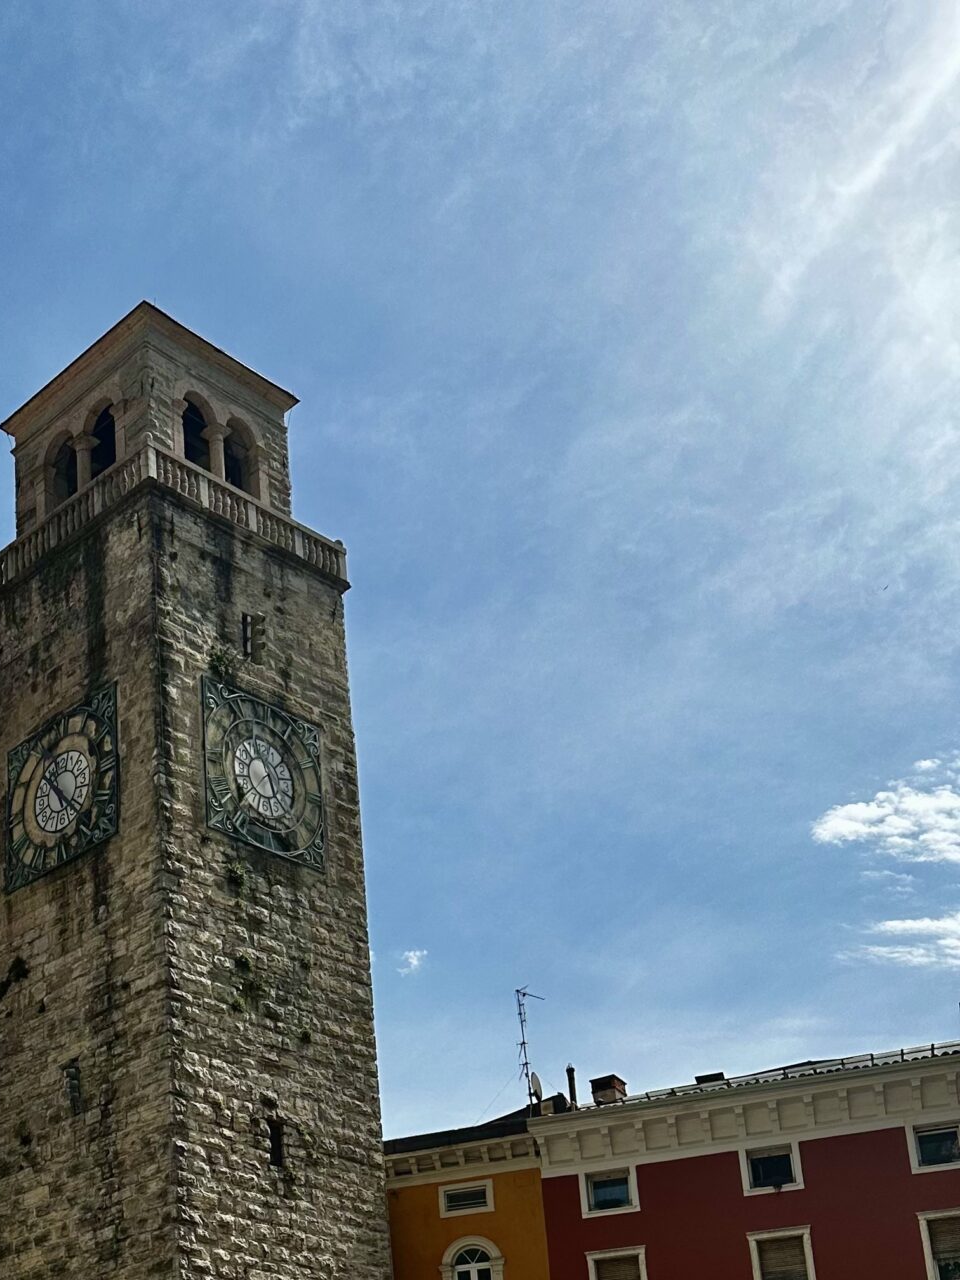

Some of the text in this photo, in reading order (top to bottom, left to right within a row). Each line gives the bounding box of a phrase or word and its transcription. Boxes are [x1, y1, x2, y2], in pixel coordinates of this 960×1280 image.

[238, 747, 248, 761] 10
[57, 757, 66, 770] 12
[76, 759, 83, 772] 2
[238, 762, 245, 774] 9
[279, 764, 286, 777] 2
[80, 772, 86, 784] 3
[242, 778, 249, 790] 8
[39, 782, 48, 797] 10
[283, 781, 289, 793] 3
[77, 788, 84, 800] 4
[250, 792, 257, 803] 7
[38, 798, 45, 811] 9
[262, 800, 269, 812] 6
[41, 811, 48, 823] 8
[50, 815, 56, 829] 7
[59, 813, 66, 826] 6
